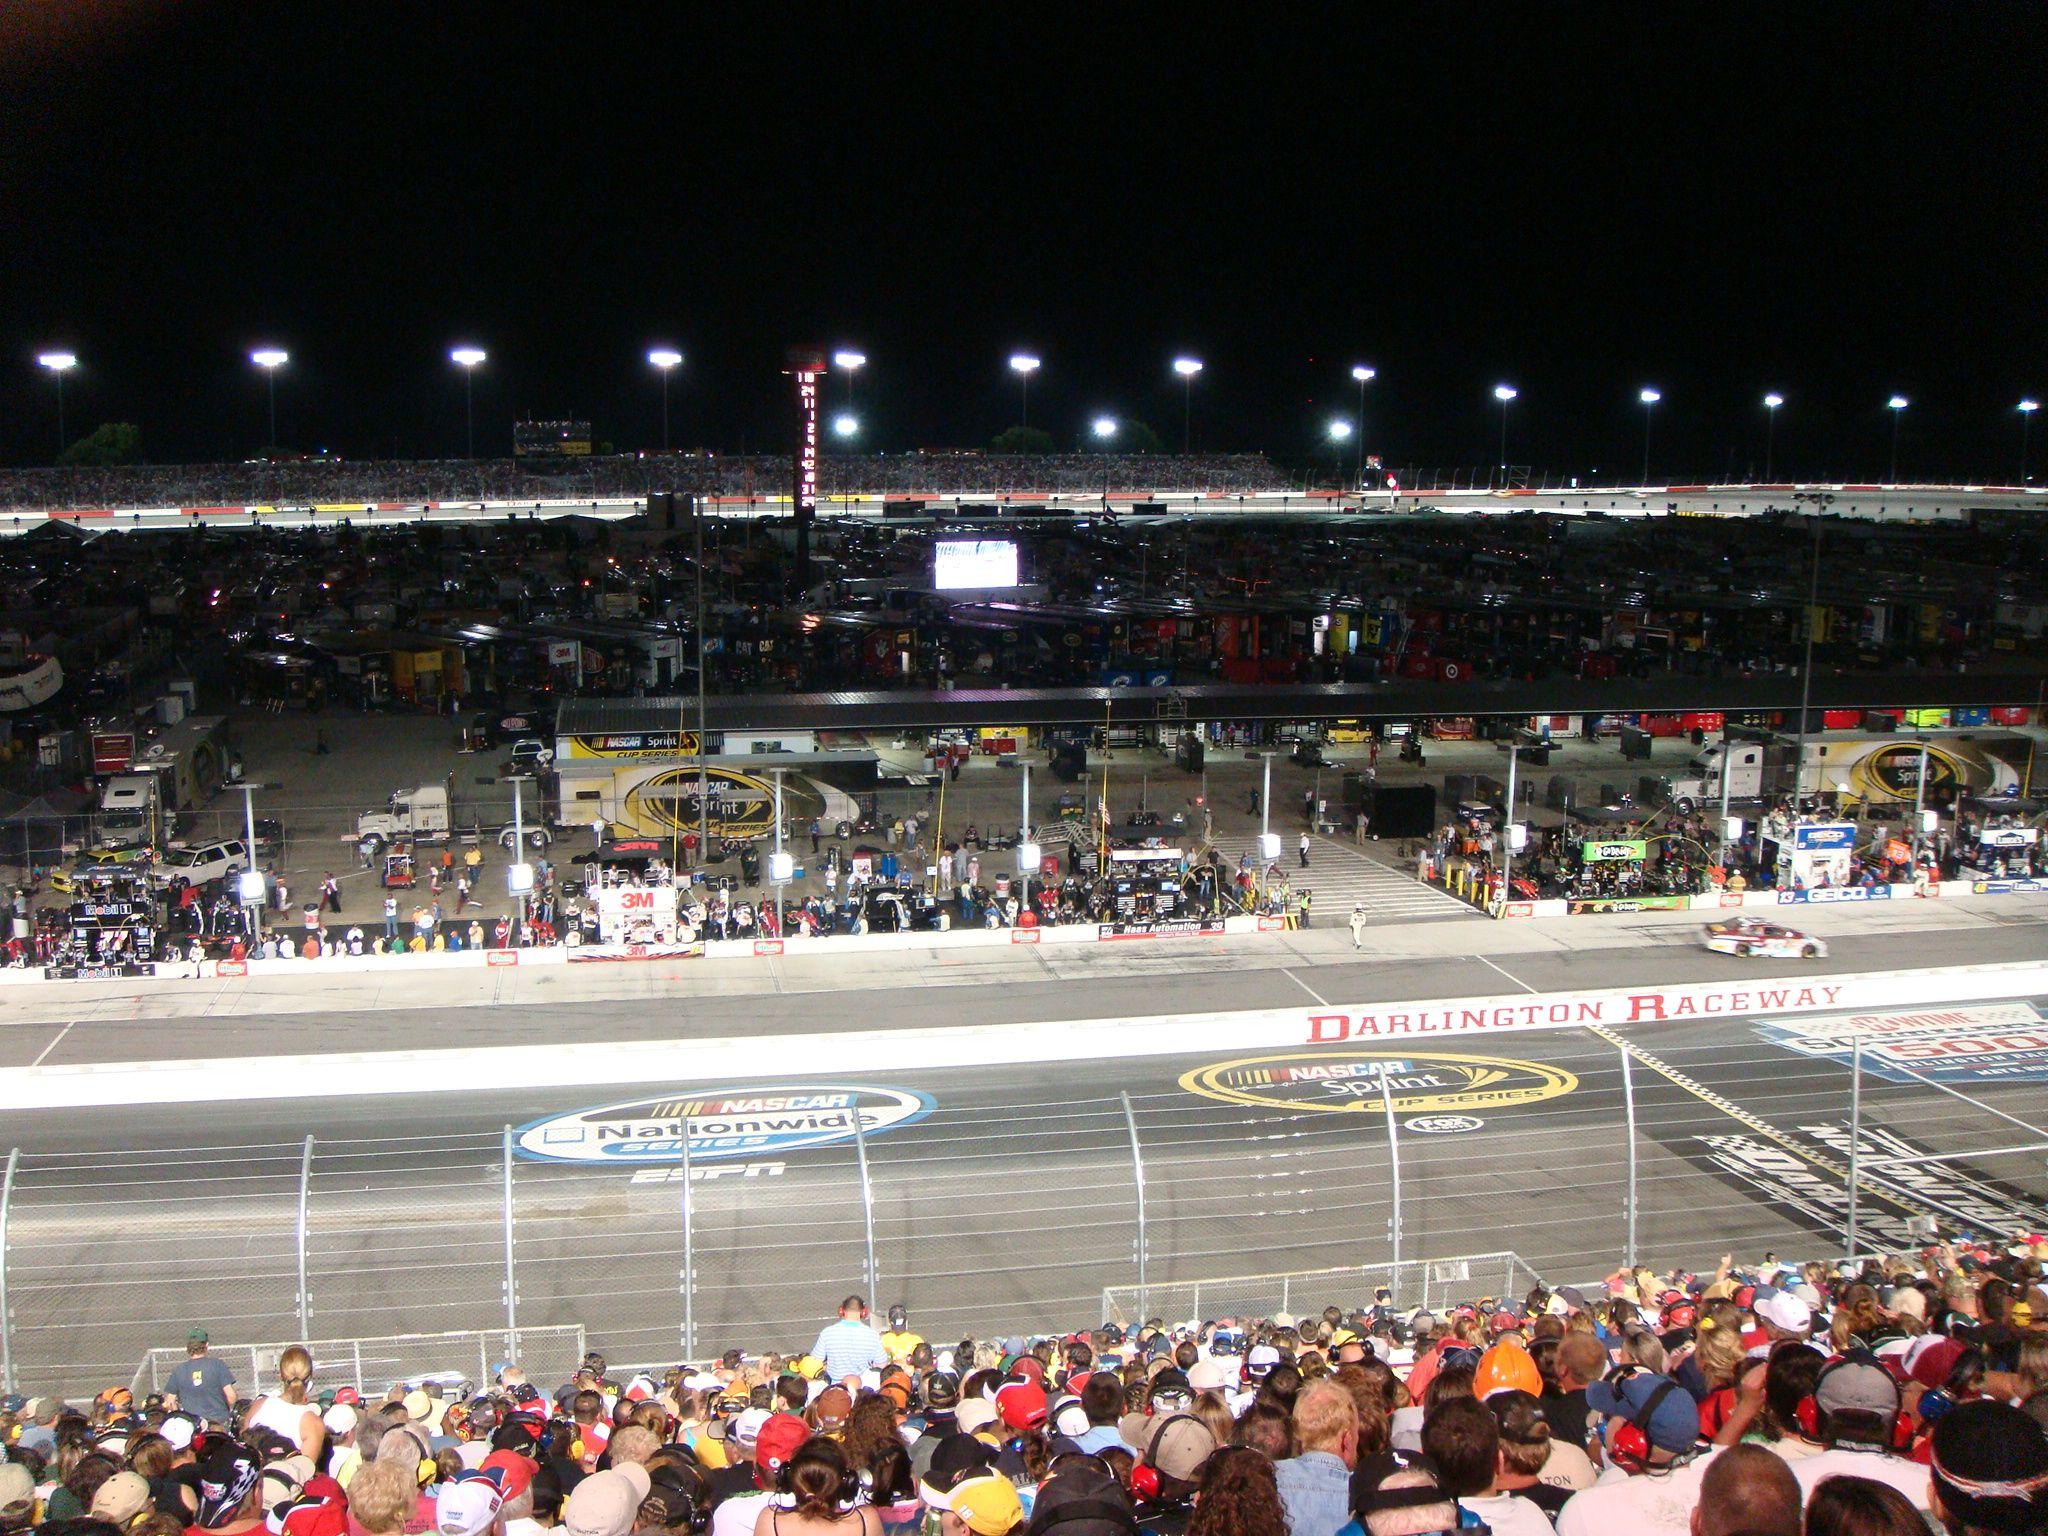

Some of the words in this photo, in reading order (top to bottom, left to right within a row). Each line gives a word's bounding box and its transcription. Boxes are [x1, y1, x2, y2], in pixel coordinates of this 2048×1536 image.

[607, 736, 641, 748] NASCAR
[647, 735, 678, 749] Sprint
[643, 750, 679, 758] SERIES
[685, 781, 730, 796] NACAR
[620, 892, 654, 909] 3M
[1779, 891, 1796, 904] 13
[1807, 886, 1867, 903] GEICO
[85, 903, 119, 916] Mobil
[1124, 923, 1148, 935] Haas
[1149, 921, 1202, 934] Automation
[1209, 920, 1224, 931] 39
[626, 945, 647, 956] 3M
[78, 967, 111, 979] Mobil
[1307, 1001, 1603, 1043] DARLINGTON
[1627, 986, 1843, 1021] RACEWAY
[1287, 1060, 1406, 1081] NASCAR
[1320, 1073, 1448, 1097] Sprint
[719, 1092, 849, 1115] NASCAR
[1437, 1089, 1545, 1105] SERIES
[597, 1110, 880, 1141] Nationwide
[617, 1134, 770, 1154] SERIES
[629, 1161, 787, 1185] ESPN
